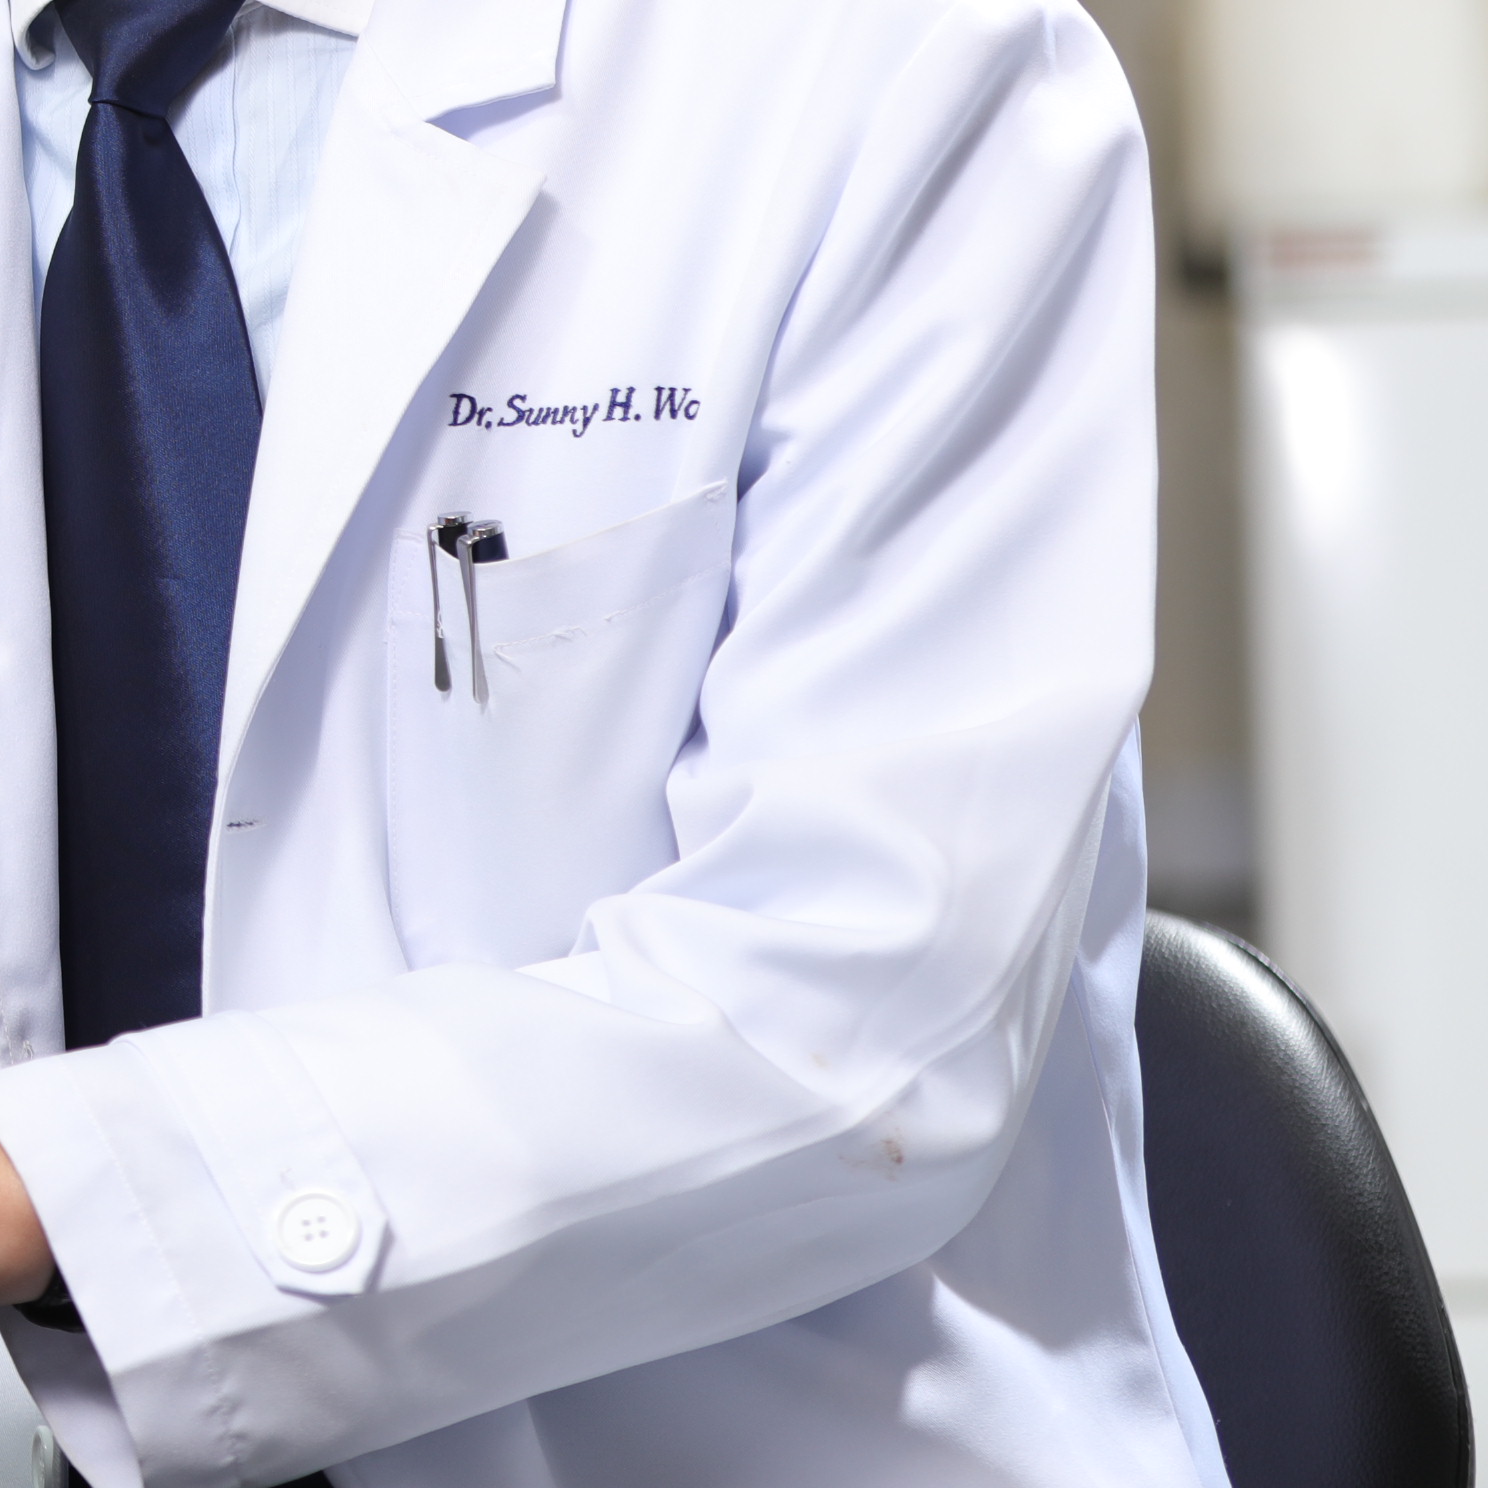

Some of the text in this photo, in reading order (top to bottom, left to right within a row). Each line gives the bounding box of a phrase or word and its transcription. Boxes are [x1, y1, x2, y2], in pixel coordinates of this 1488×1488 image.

[448, 392, 493, 430] Dr.
[496, 393, 600, 438] Sunny
[602, 385, 642, 423] H.
